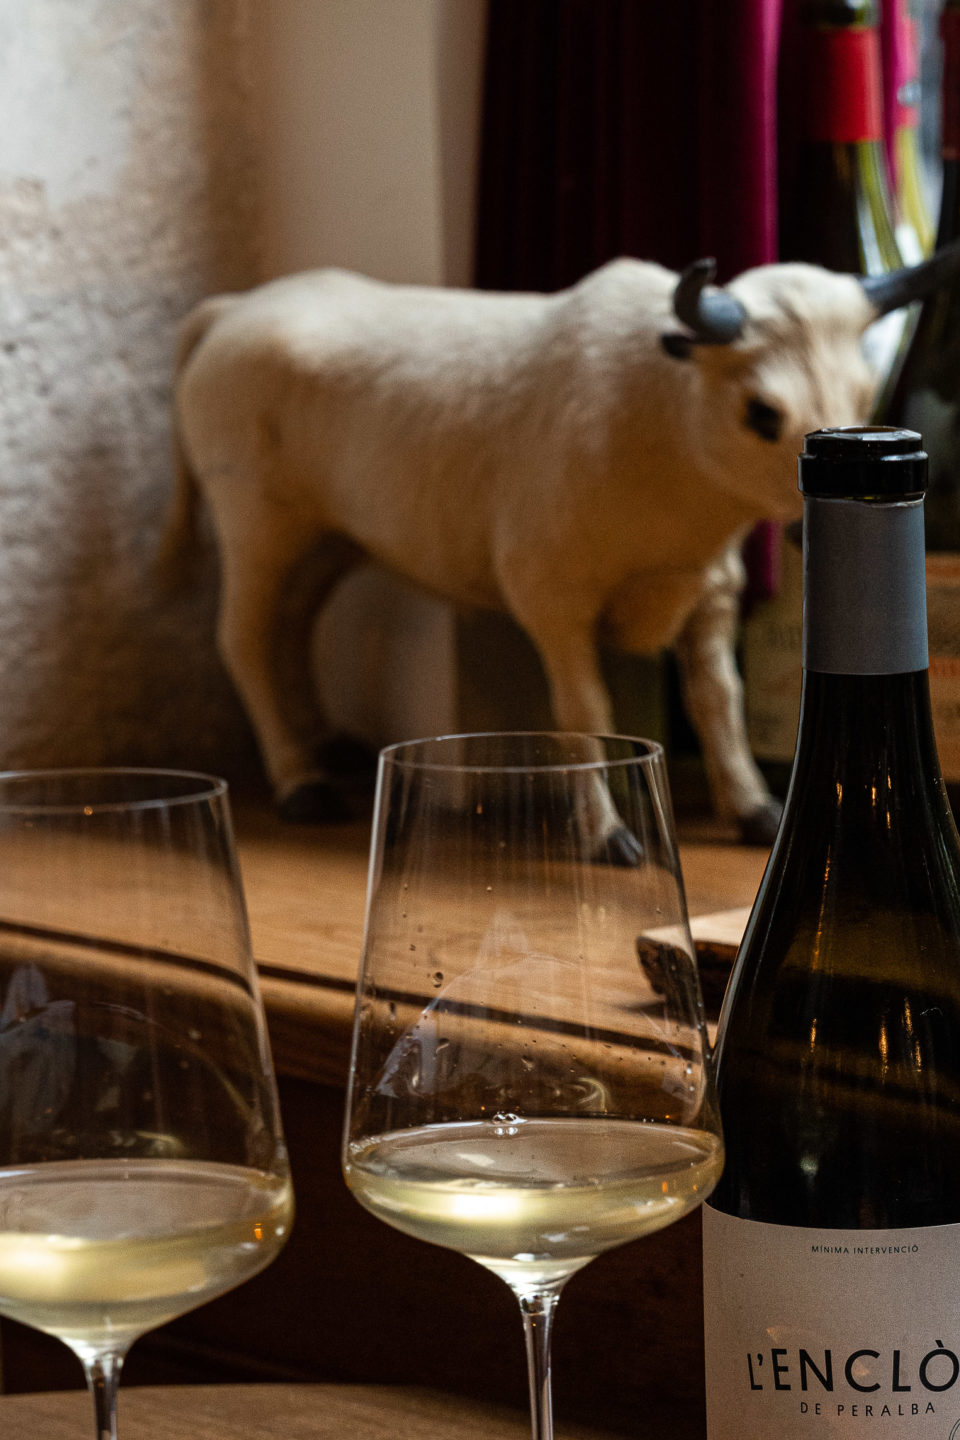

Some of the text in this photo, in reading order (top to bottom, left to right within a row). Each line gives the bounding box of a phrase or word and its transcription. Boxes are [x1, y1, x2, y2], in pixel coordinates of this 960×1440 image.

[853, 1244, 919, 1255] INTERVENCIÓ
[800, 1401, 936, 1417] DE PERALBA
